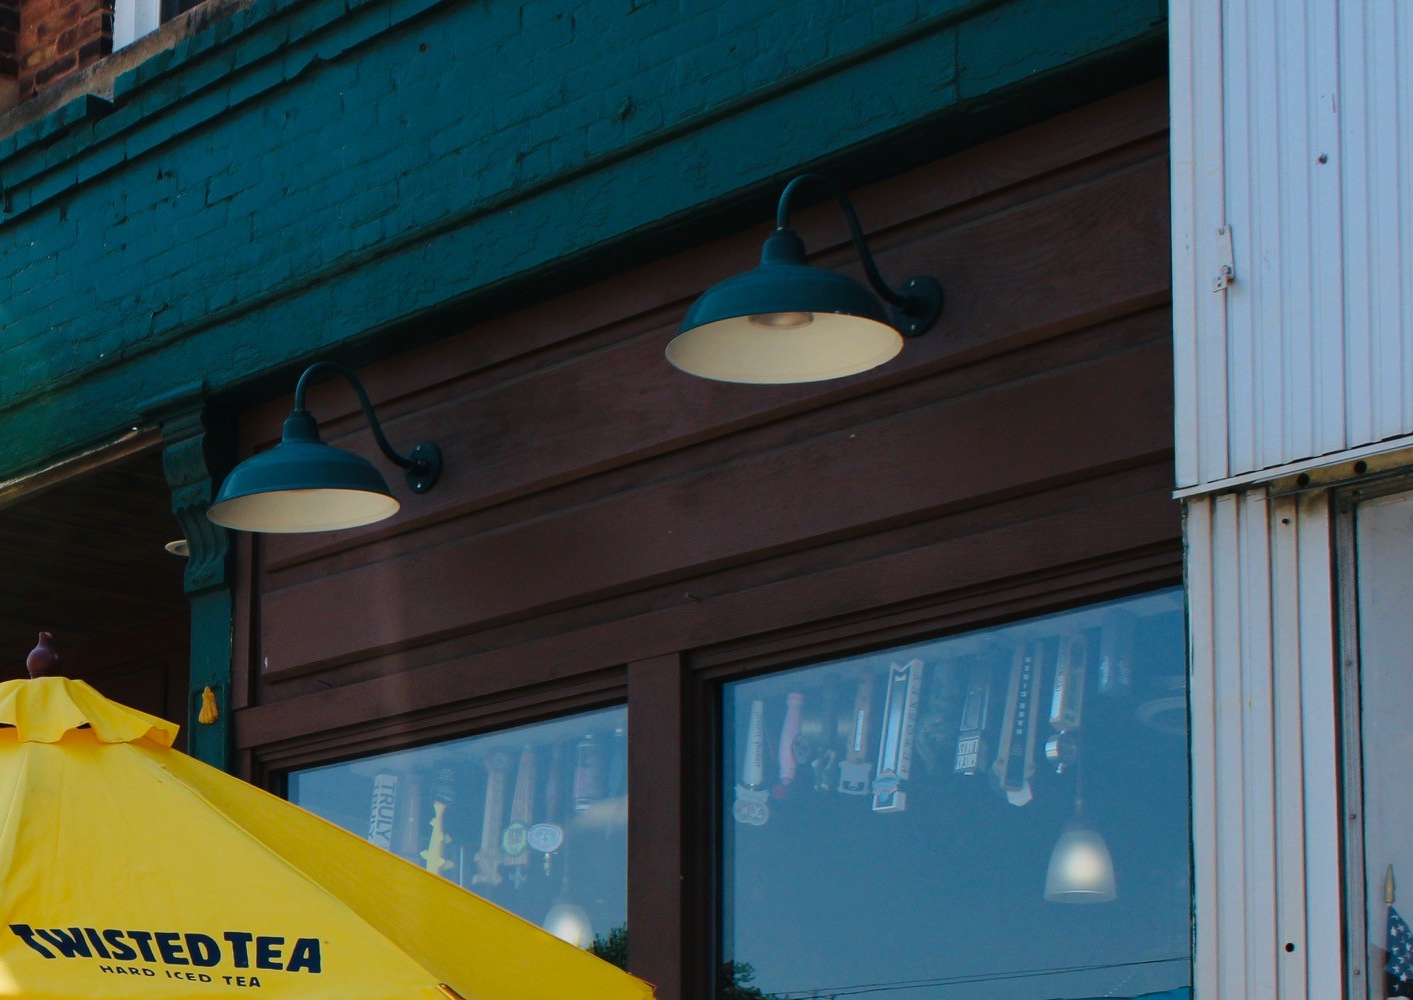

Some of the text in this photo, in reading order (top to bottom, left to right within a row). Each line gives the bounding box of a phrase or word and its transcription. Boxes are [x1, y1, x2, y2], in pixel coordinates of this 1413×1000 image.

[376, 784, 395, 841] TRULY
[9, 924, 322, 973] TWISTED TEA
[100, 965, 261, 987] HARD ICED TEA
